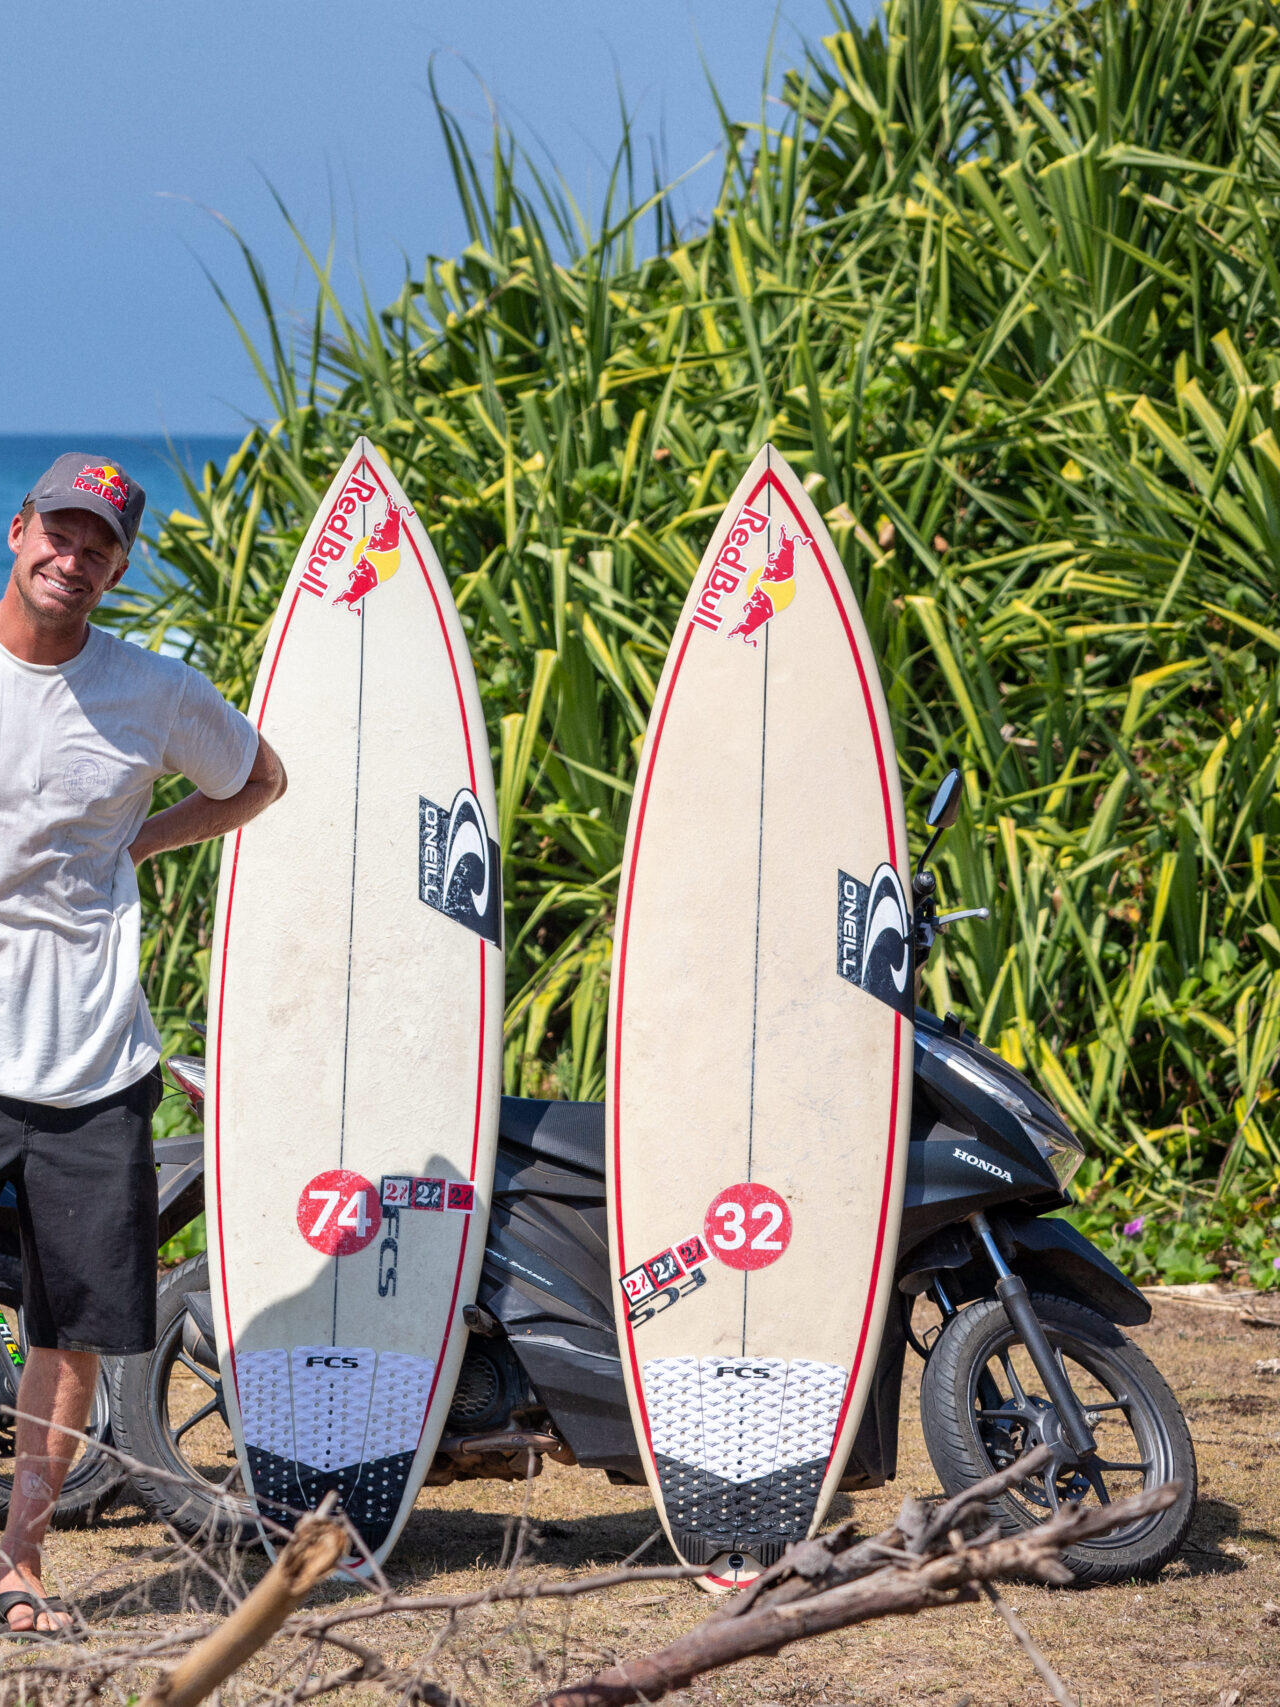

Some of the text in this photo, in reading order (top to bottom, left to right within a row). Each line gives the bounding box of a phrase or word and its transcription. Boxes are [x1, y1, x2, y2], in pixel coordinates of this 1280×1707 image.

[73, 477, 125, 511] Red Bull
[298, 476, 376, 598] Red Bull
[692, 507, 770, 632] Red Bull
[952, 1147, 1013, 1184] HONDA
[308, 1190, 371, 1237] 74
[713, 1202, 783, 1251] 32
[378, 1206, 399, 1297] FCS
[627, 1267, 707, 1330] FCS
[305, 1356, 359, 1369] FCS
[716, 1366, 770, 1379] FCS
